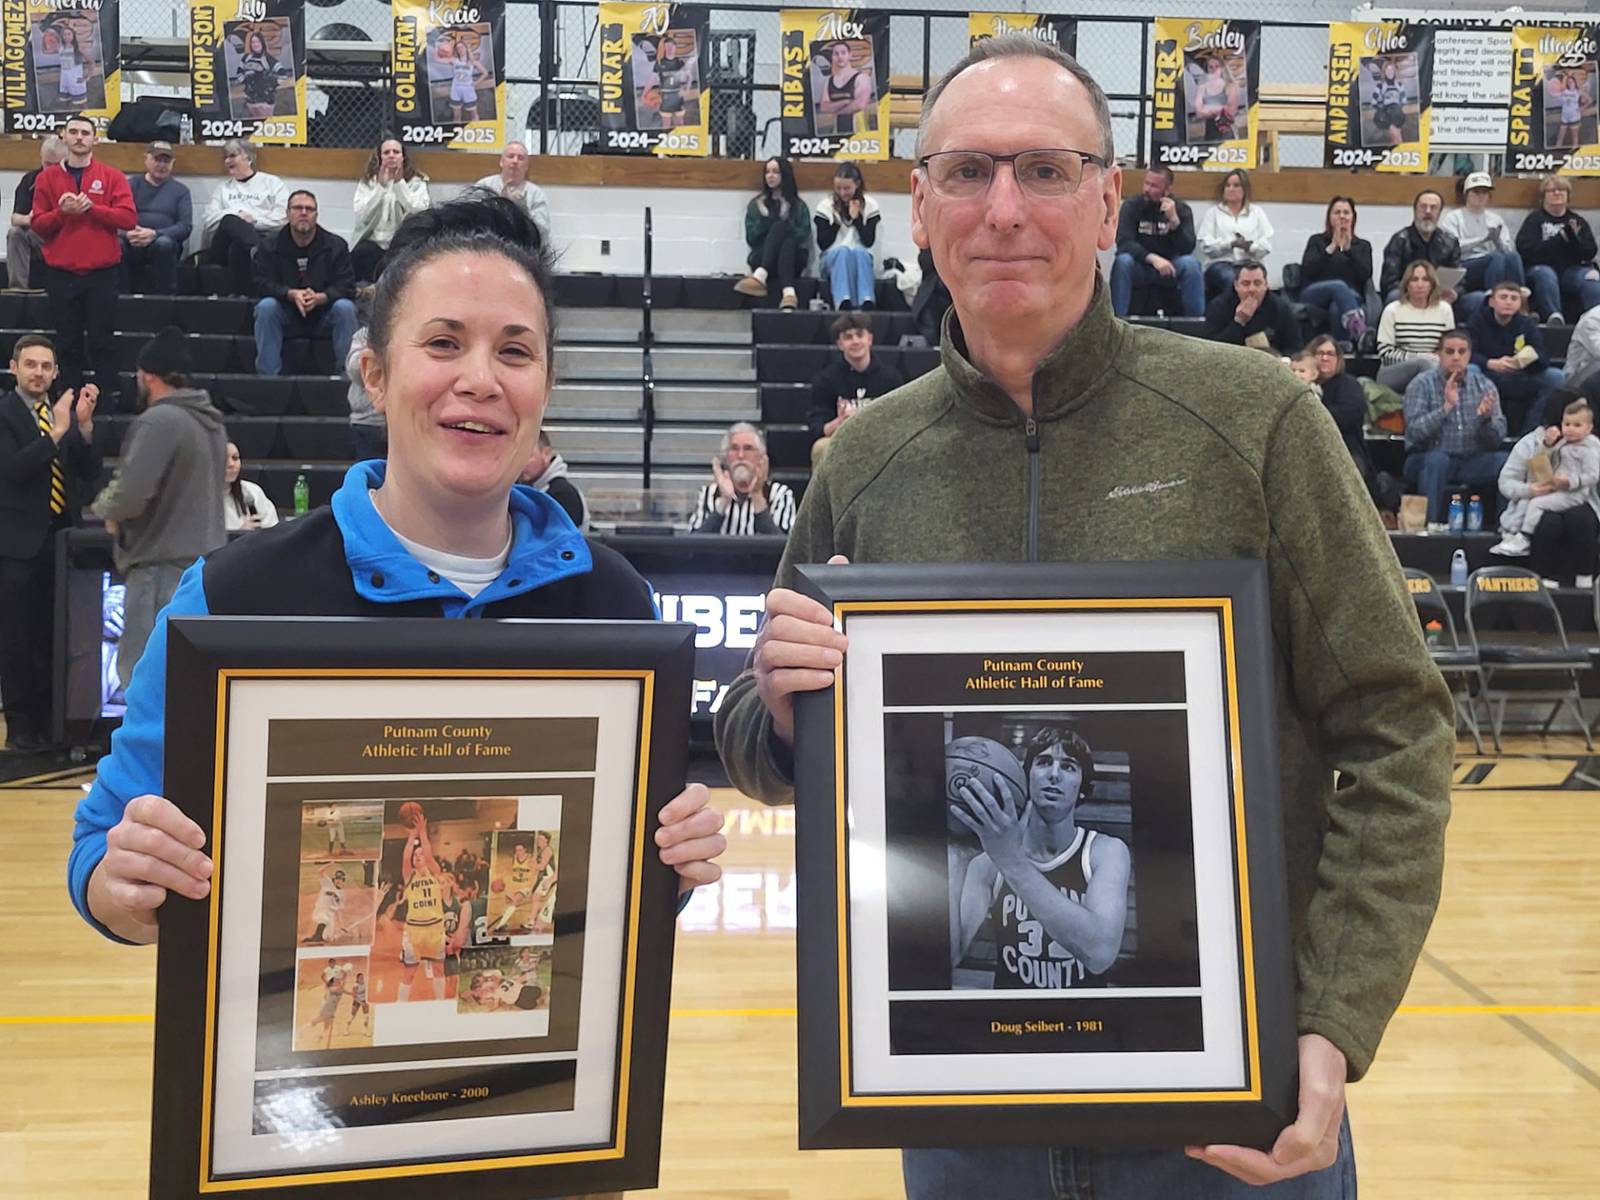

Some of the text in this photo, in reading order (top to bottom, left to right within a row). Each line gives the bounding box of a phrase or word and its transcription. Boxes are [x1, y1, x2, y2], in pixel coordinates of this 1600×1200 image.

[428, 2, 481, 27] Kacie
[816, 11, 865, 41] Alex
[1184, 22, 1246, 54] Bailey
[1365, 26, 1408, 53] Chloe
[1538, 37, 1598, 67] Maggie
[193, 4, 215, 108] THOMPSON
[395, 19, 416, 113] COLEMAN
[602, 40, 625, 113] FURAR
[783, 46, 804, 118] RIBAS
[1155, 50, 1178, 129] HERR
[1328, 43, 1352, 144] ANDERSEN
[1511, 48, 1534, 146] SPRATT
[1477, 577, 1539, 592] PANTHERS
[984, 658, 1084, 674] Putnam County
[965, 675, 1104, 690] Athletic Hall of Fame
[383, 724, 492, 742] Putnam County
[361, 742, 512, 759] Athletic Hall of Fame
[991, 1021, 1022, 1036] Doug
[1025, 1020, 1064, 1032] Seibert
[1076, 1020, 1103, 1032] 1981
[350, 1093, 388, 1107] Ashley
[391, 1089, 449, 1105] Kneebone
[460, 1086, 489, 1099] 2000
